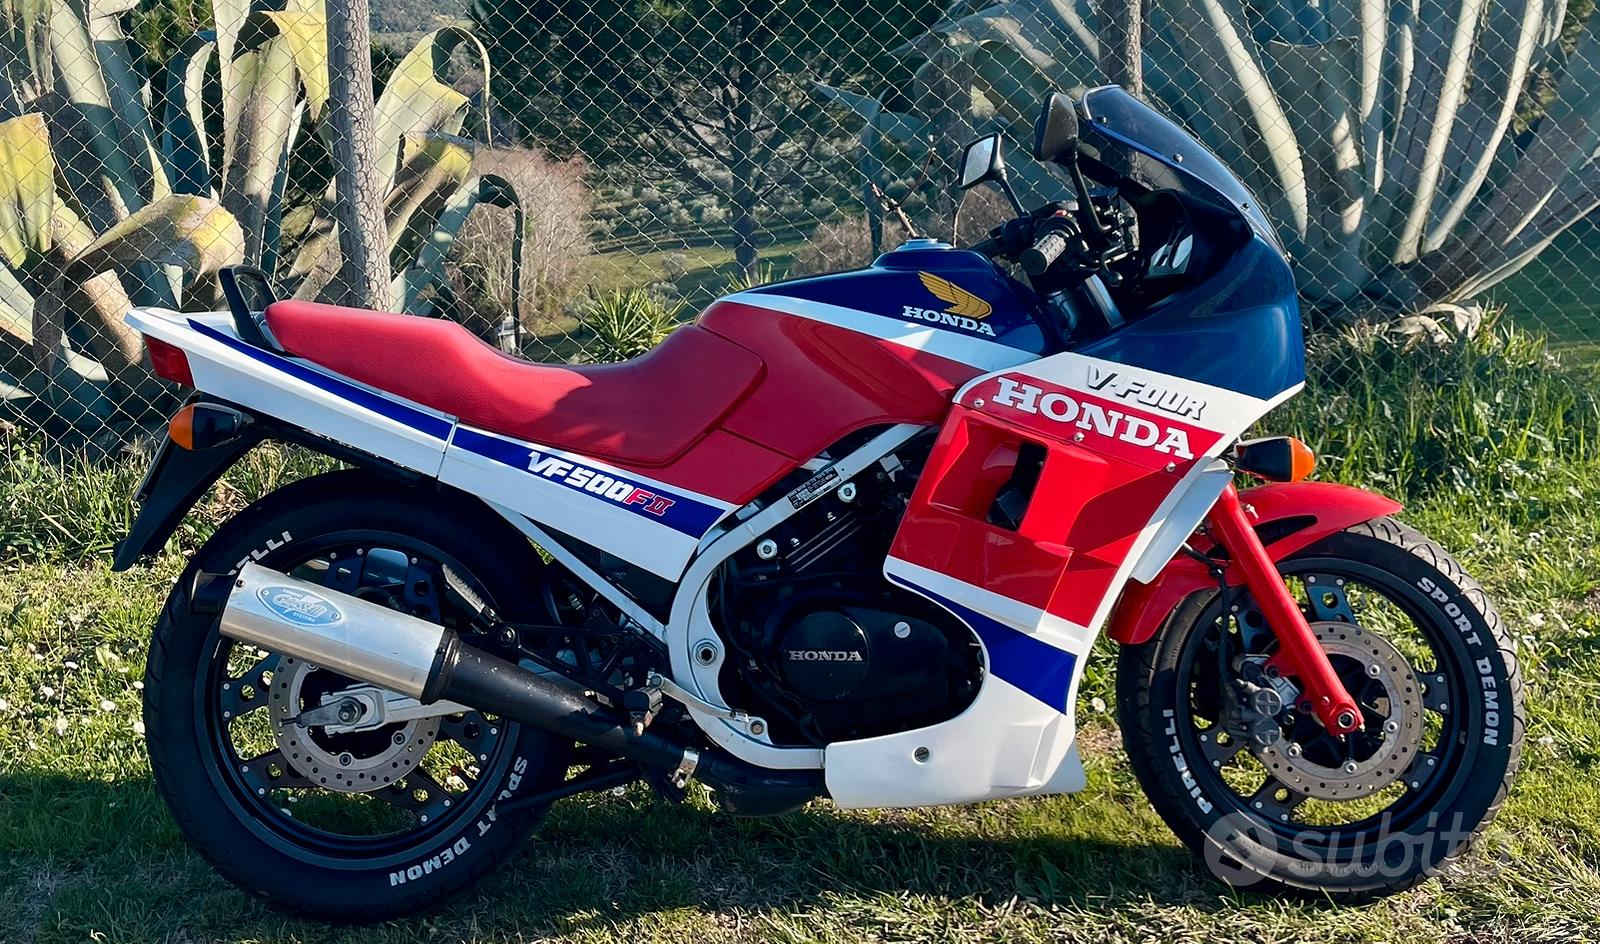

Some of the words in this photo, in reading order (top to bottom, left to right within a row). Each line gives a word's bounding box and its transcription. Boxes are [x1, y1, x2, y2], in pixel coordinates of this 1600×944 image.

[902, 305, 996, 337] HONDA
[992, 376, 1194, 460] HONDA
[1087, 364, 1207, 420] V-FOUR
[788, 650, 863, 662] HONDA
[1416, 576, 1482, 647] SPORT
[1475, 656, 1499, 746] DEMON
[1162, 709, 1213, 814] PIRELLI
[389, 837, 472, 887] DEMON
